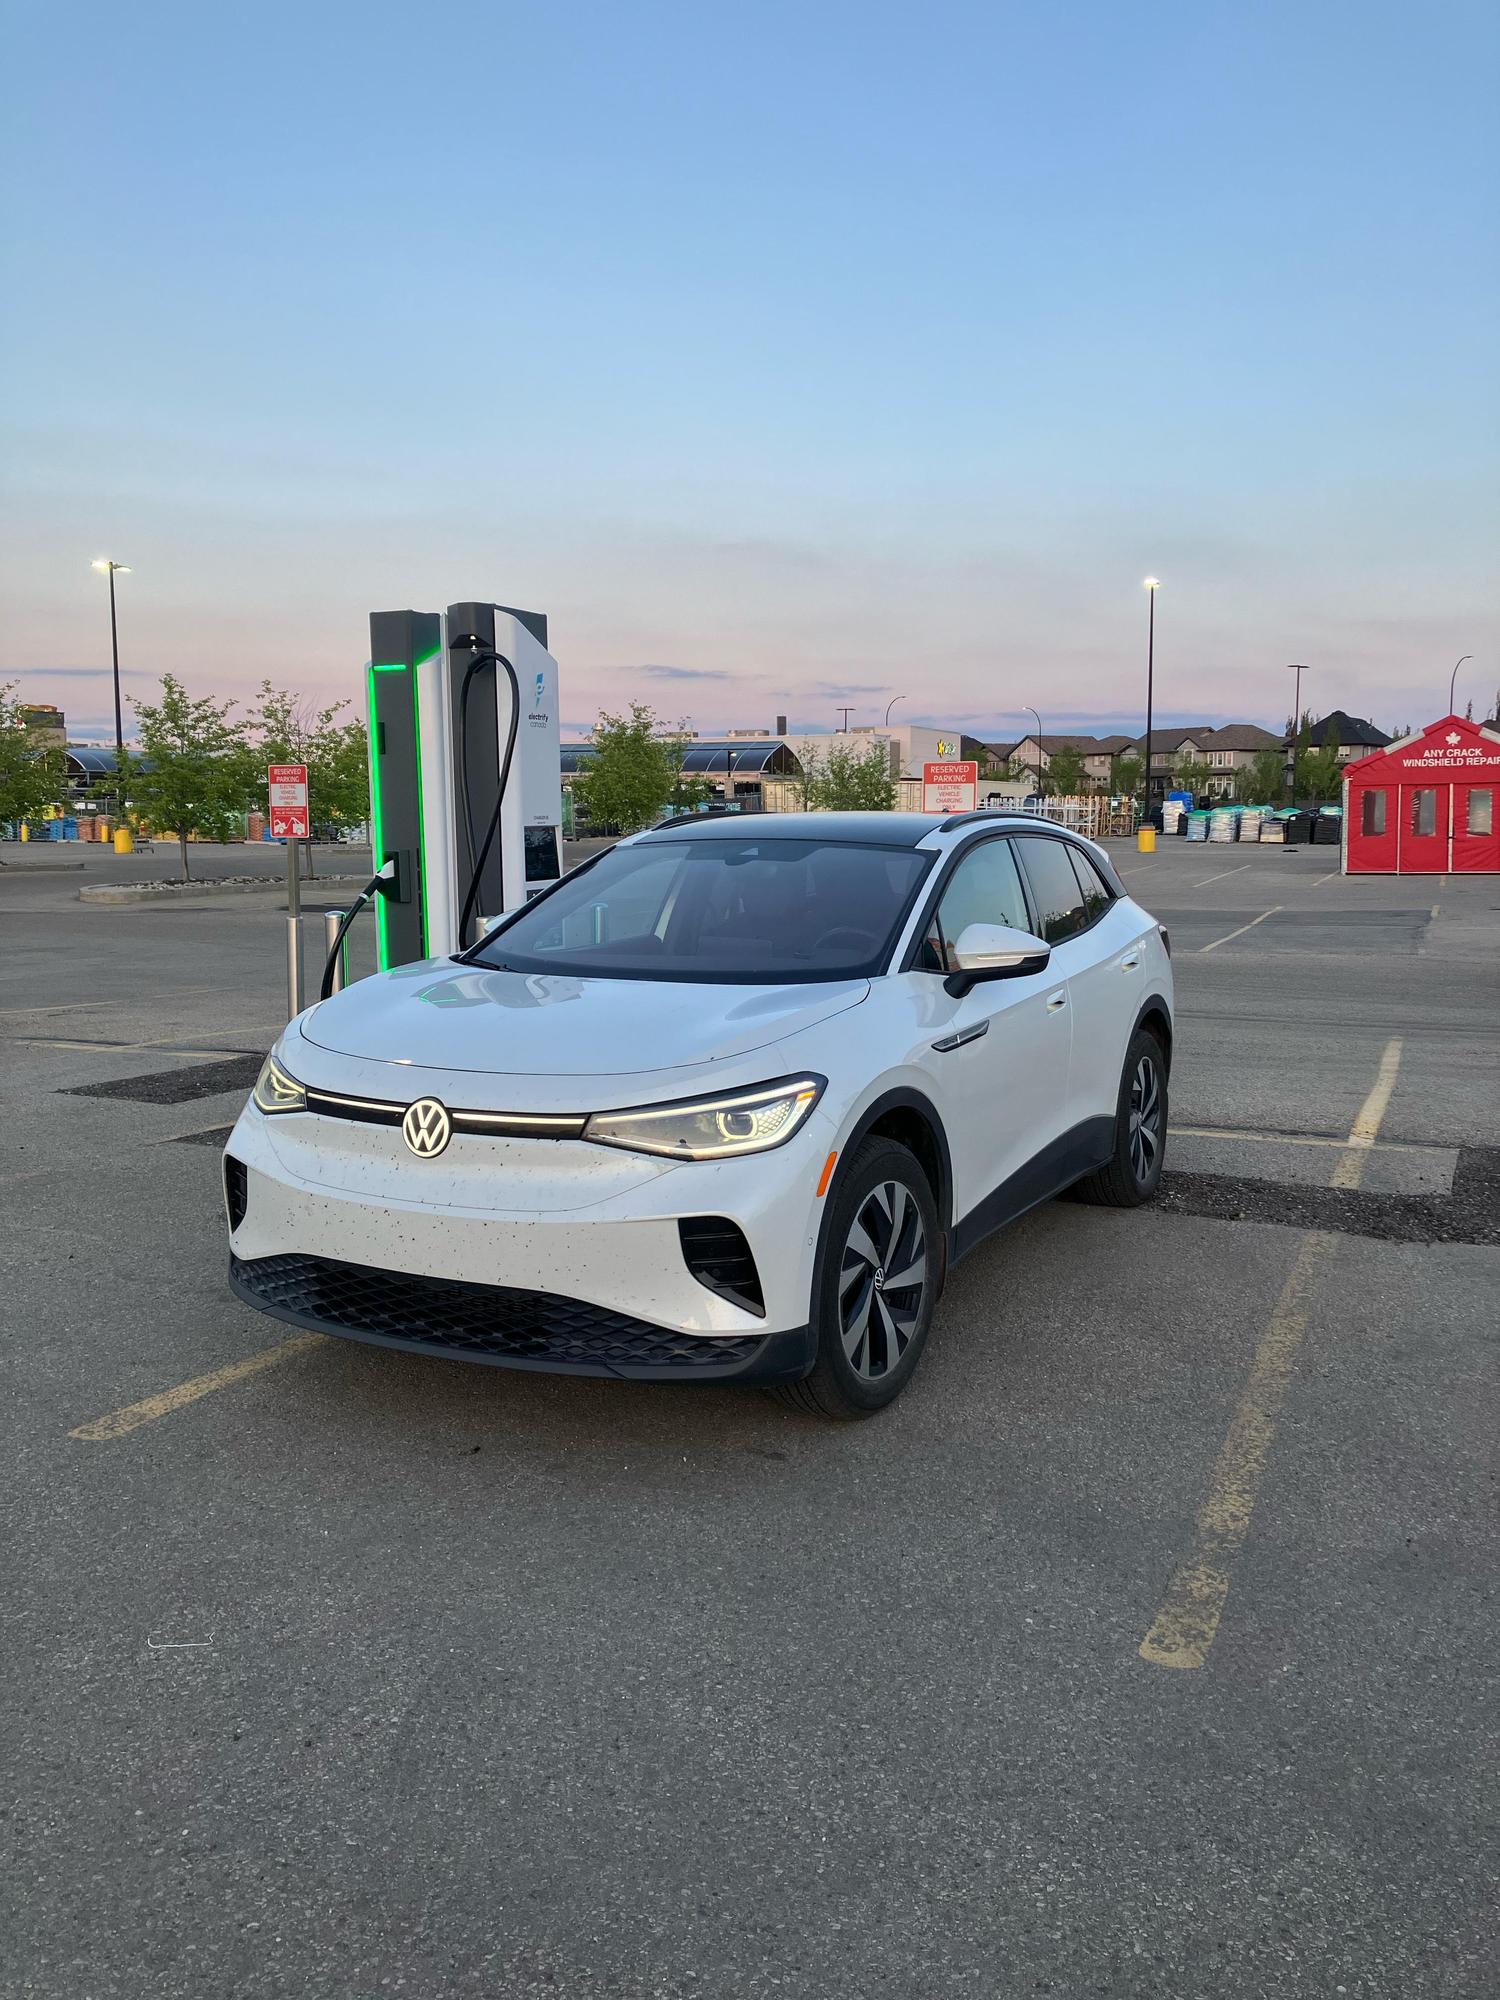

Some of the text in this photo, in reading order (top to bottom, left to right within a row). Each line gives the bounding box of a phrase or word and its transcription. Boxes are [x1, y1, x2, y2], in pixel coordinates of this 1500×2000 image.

[1423, 748, 1483, 758] ANY CRACK
[1402, 758, 1464, 767] WINDSHIELD
[930, 765, 970, 773] RESERVED
[933, 775, 967, 783] PARKING
